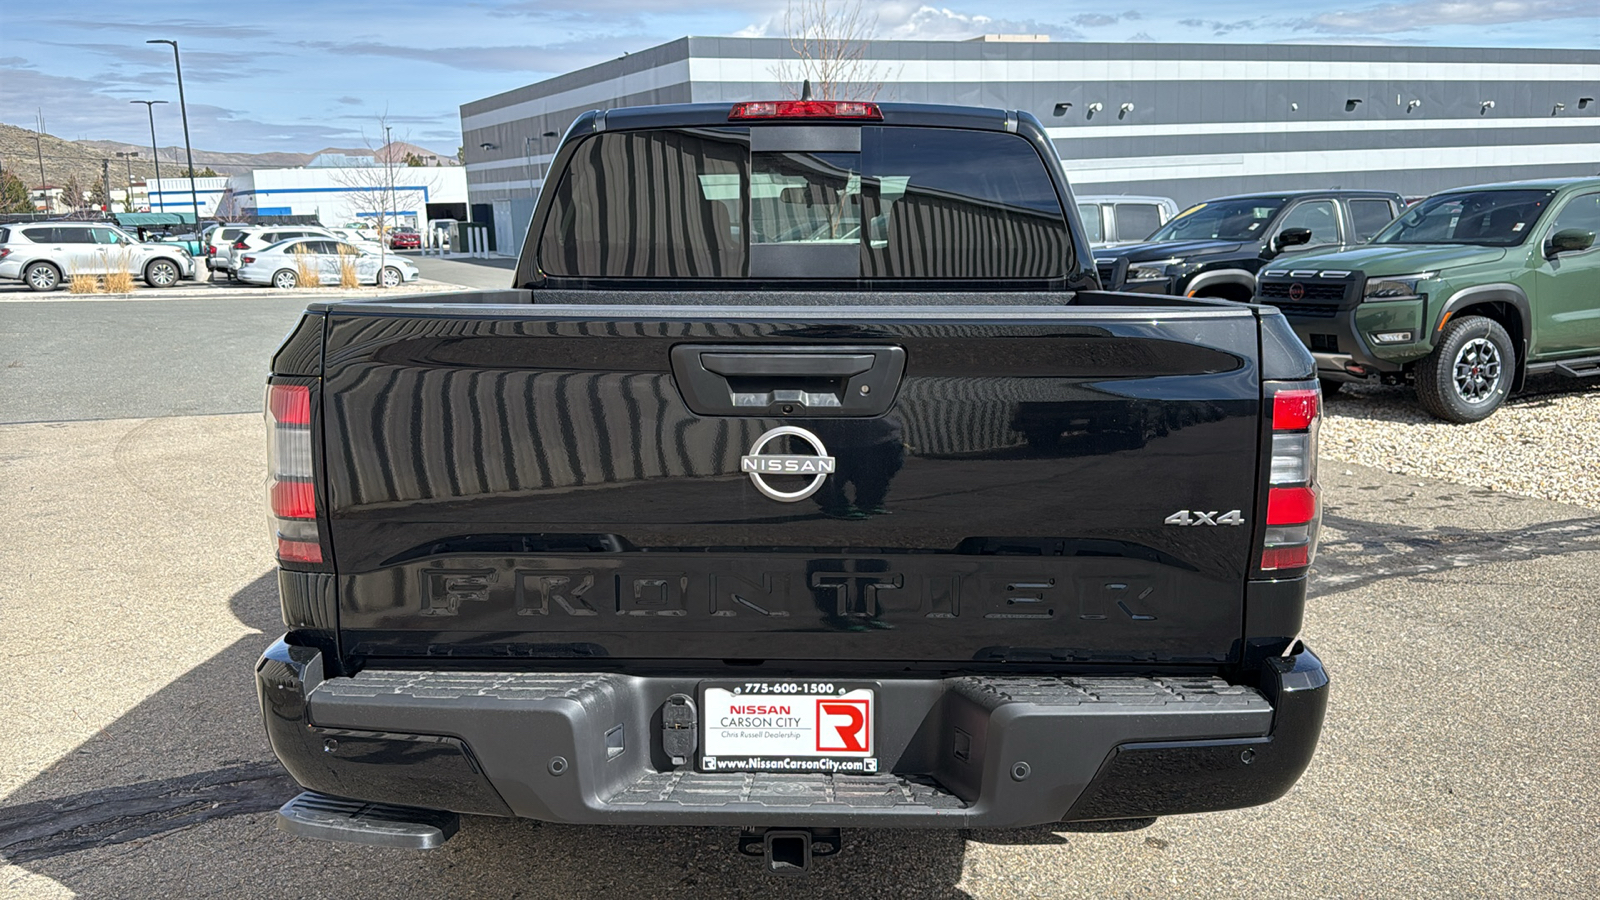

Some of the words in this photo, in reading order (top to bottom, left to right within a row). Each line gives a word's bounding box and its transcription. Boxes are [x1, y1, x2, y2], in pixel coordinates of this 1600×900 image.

[743, 458, 834, 472] NISSAN
[419, 567, 1157, 621] FRONTIER
[744, 683, 834, 694] 775-600-1500
[730, 705, 791, 715] NISSAN
[720, 717, 773, 728] CARSON
[775, 717, 801, 728] CITY
[721, 730, 739, 738] Chris
[740, 730, 763, 738] Russell
[764, 731, 801, 740] Dealership
[717, 757, 863, 772] www.NissanCarsonCity.com
